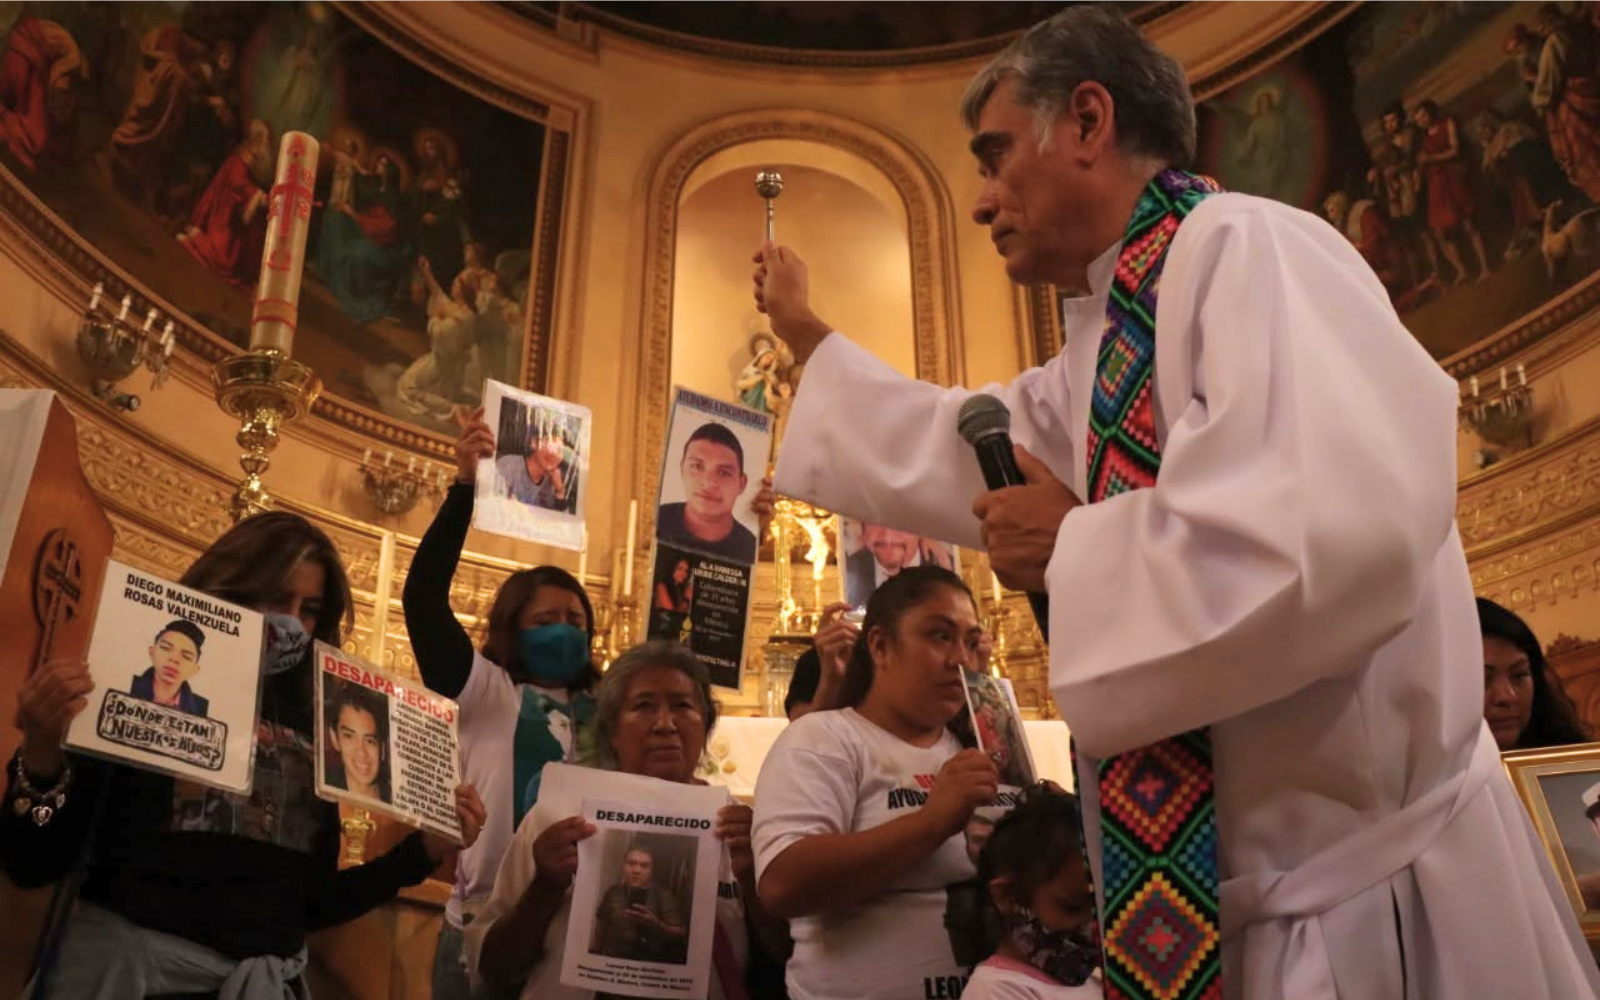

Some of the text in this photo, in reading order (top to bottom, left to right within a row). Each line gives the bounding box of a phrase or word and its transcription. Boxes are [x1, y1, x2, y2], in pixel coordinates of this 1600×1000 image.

[124, 587, 240, 637] ROSAS VALENZUELA
[127, 573, 242, 623] DIEGO MAXIMILIANO
[324, 655, 454, 723] DESAPARECIDO
[596, 810, 711, 830] DESAPARECIDO
